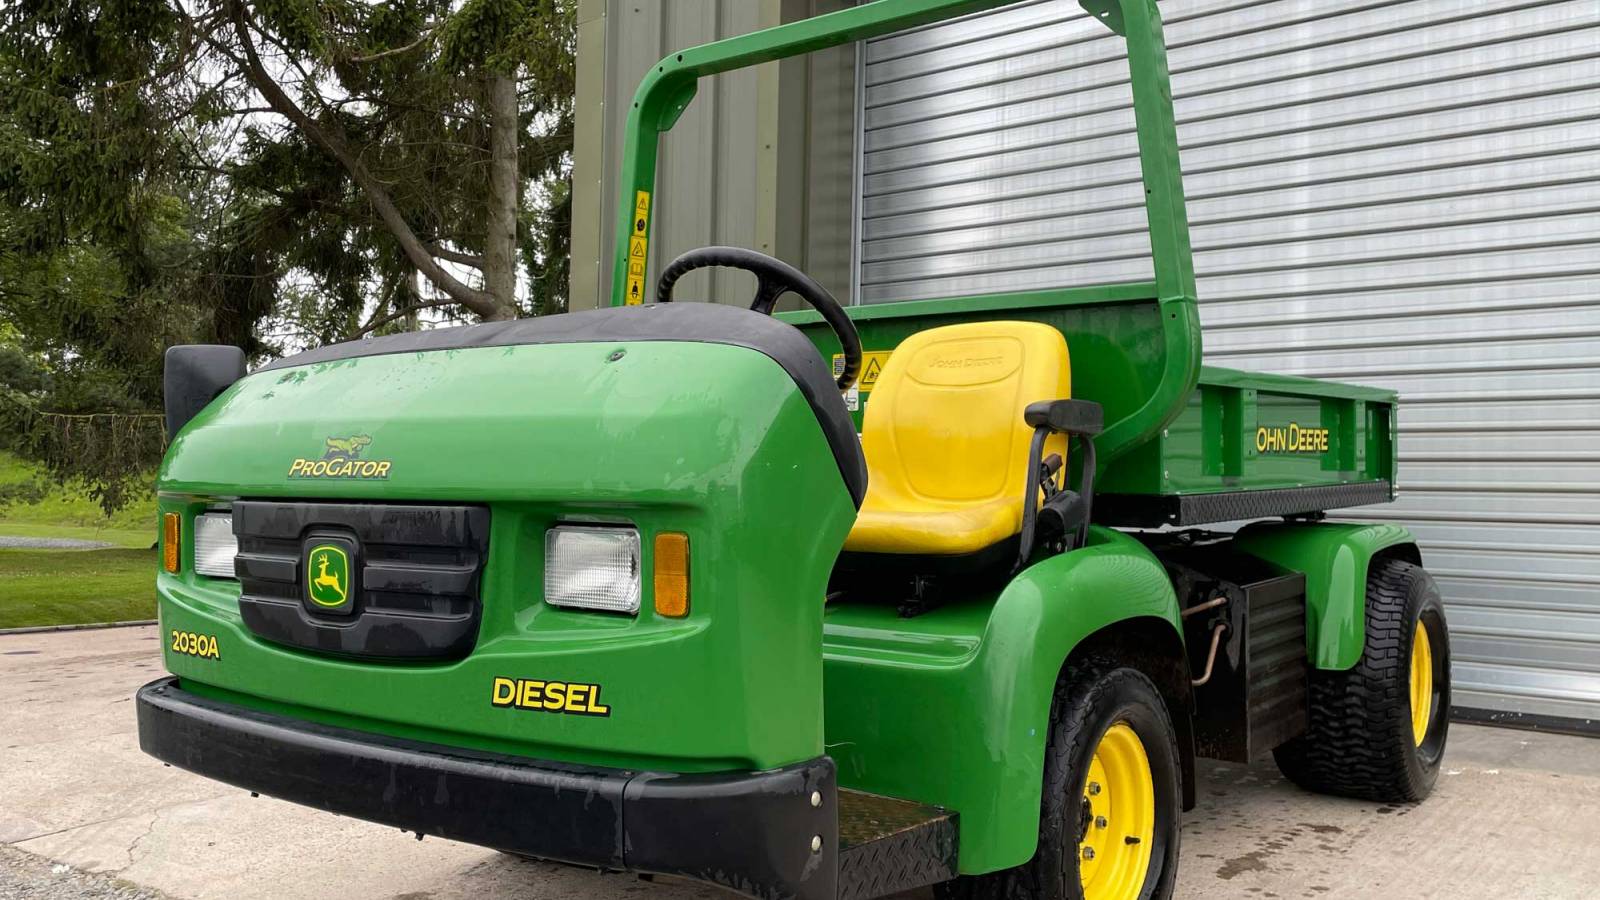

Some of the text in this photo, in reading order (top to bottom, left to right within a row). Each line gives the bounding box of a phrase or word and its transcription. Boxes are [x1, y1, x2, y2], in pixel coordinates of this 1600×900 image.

[1256, 422, 1329, 452] OHN DEERE
[172, 630, 220, 659] 2030A
[492, 677, 609, 715] DIESEL
